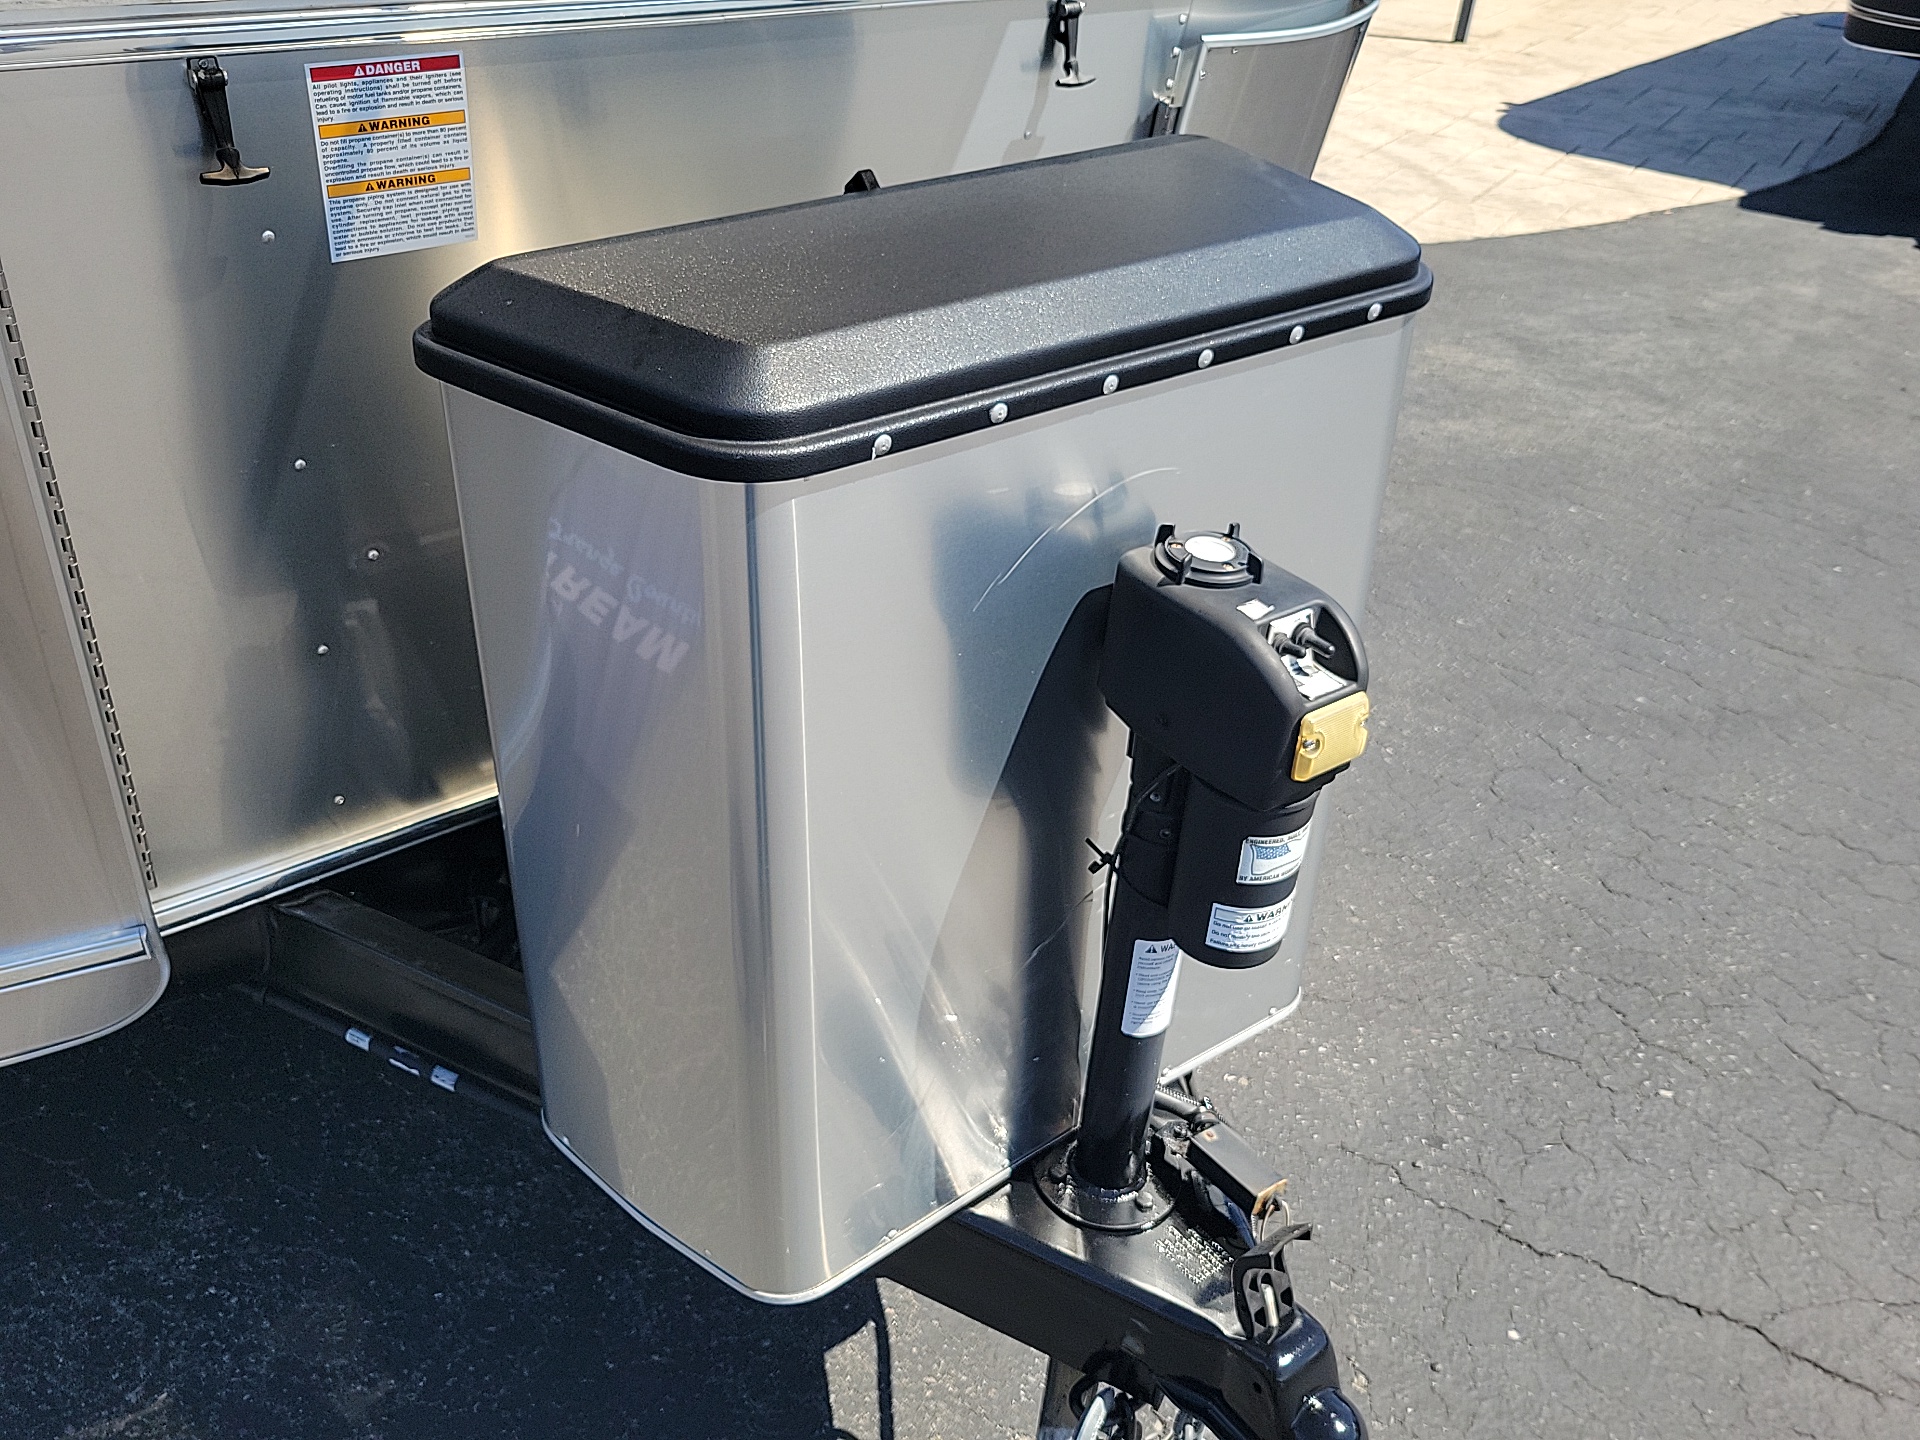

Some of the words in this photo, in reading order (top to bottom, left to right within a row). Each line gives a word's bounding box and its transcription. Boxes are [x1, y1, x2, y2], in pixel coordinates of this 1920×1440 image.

[365, 61, 420, 74] DANGER
[425, 72, 447, 80] igniters
[344, 85, 382, 93] instructions)
[369, 116, 430, 130] WARNING
[376, 174, 436, 189] WARNING
